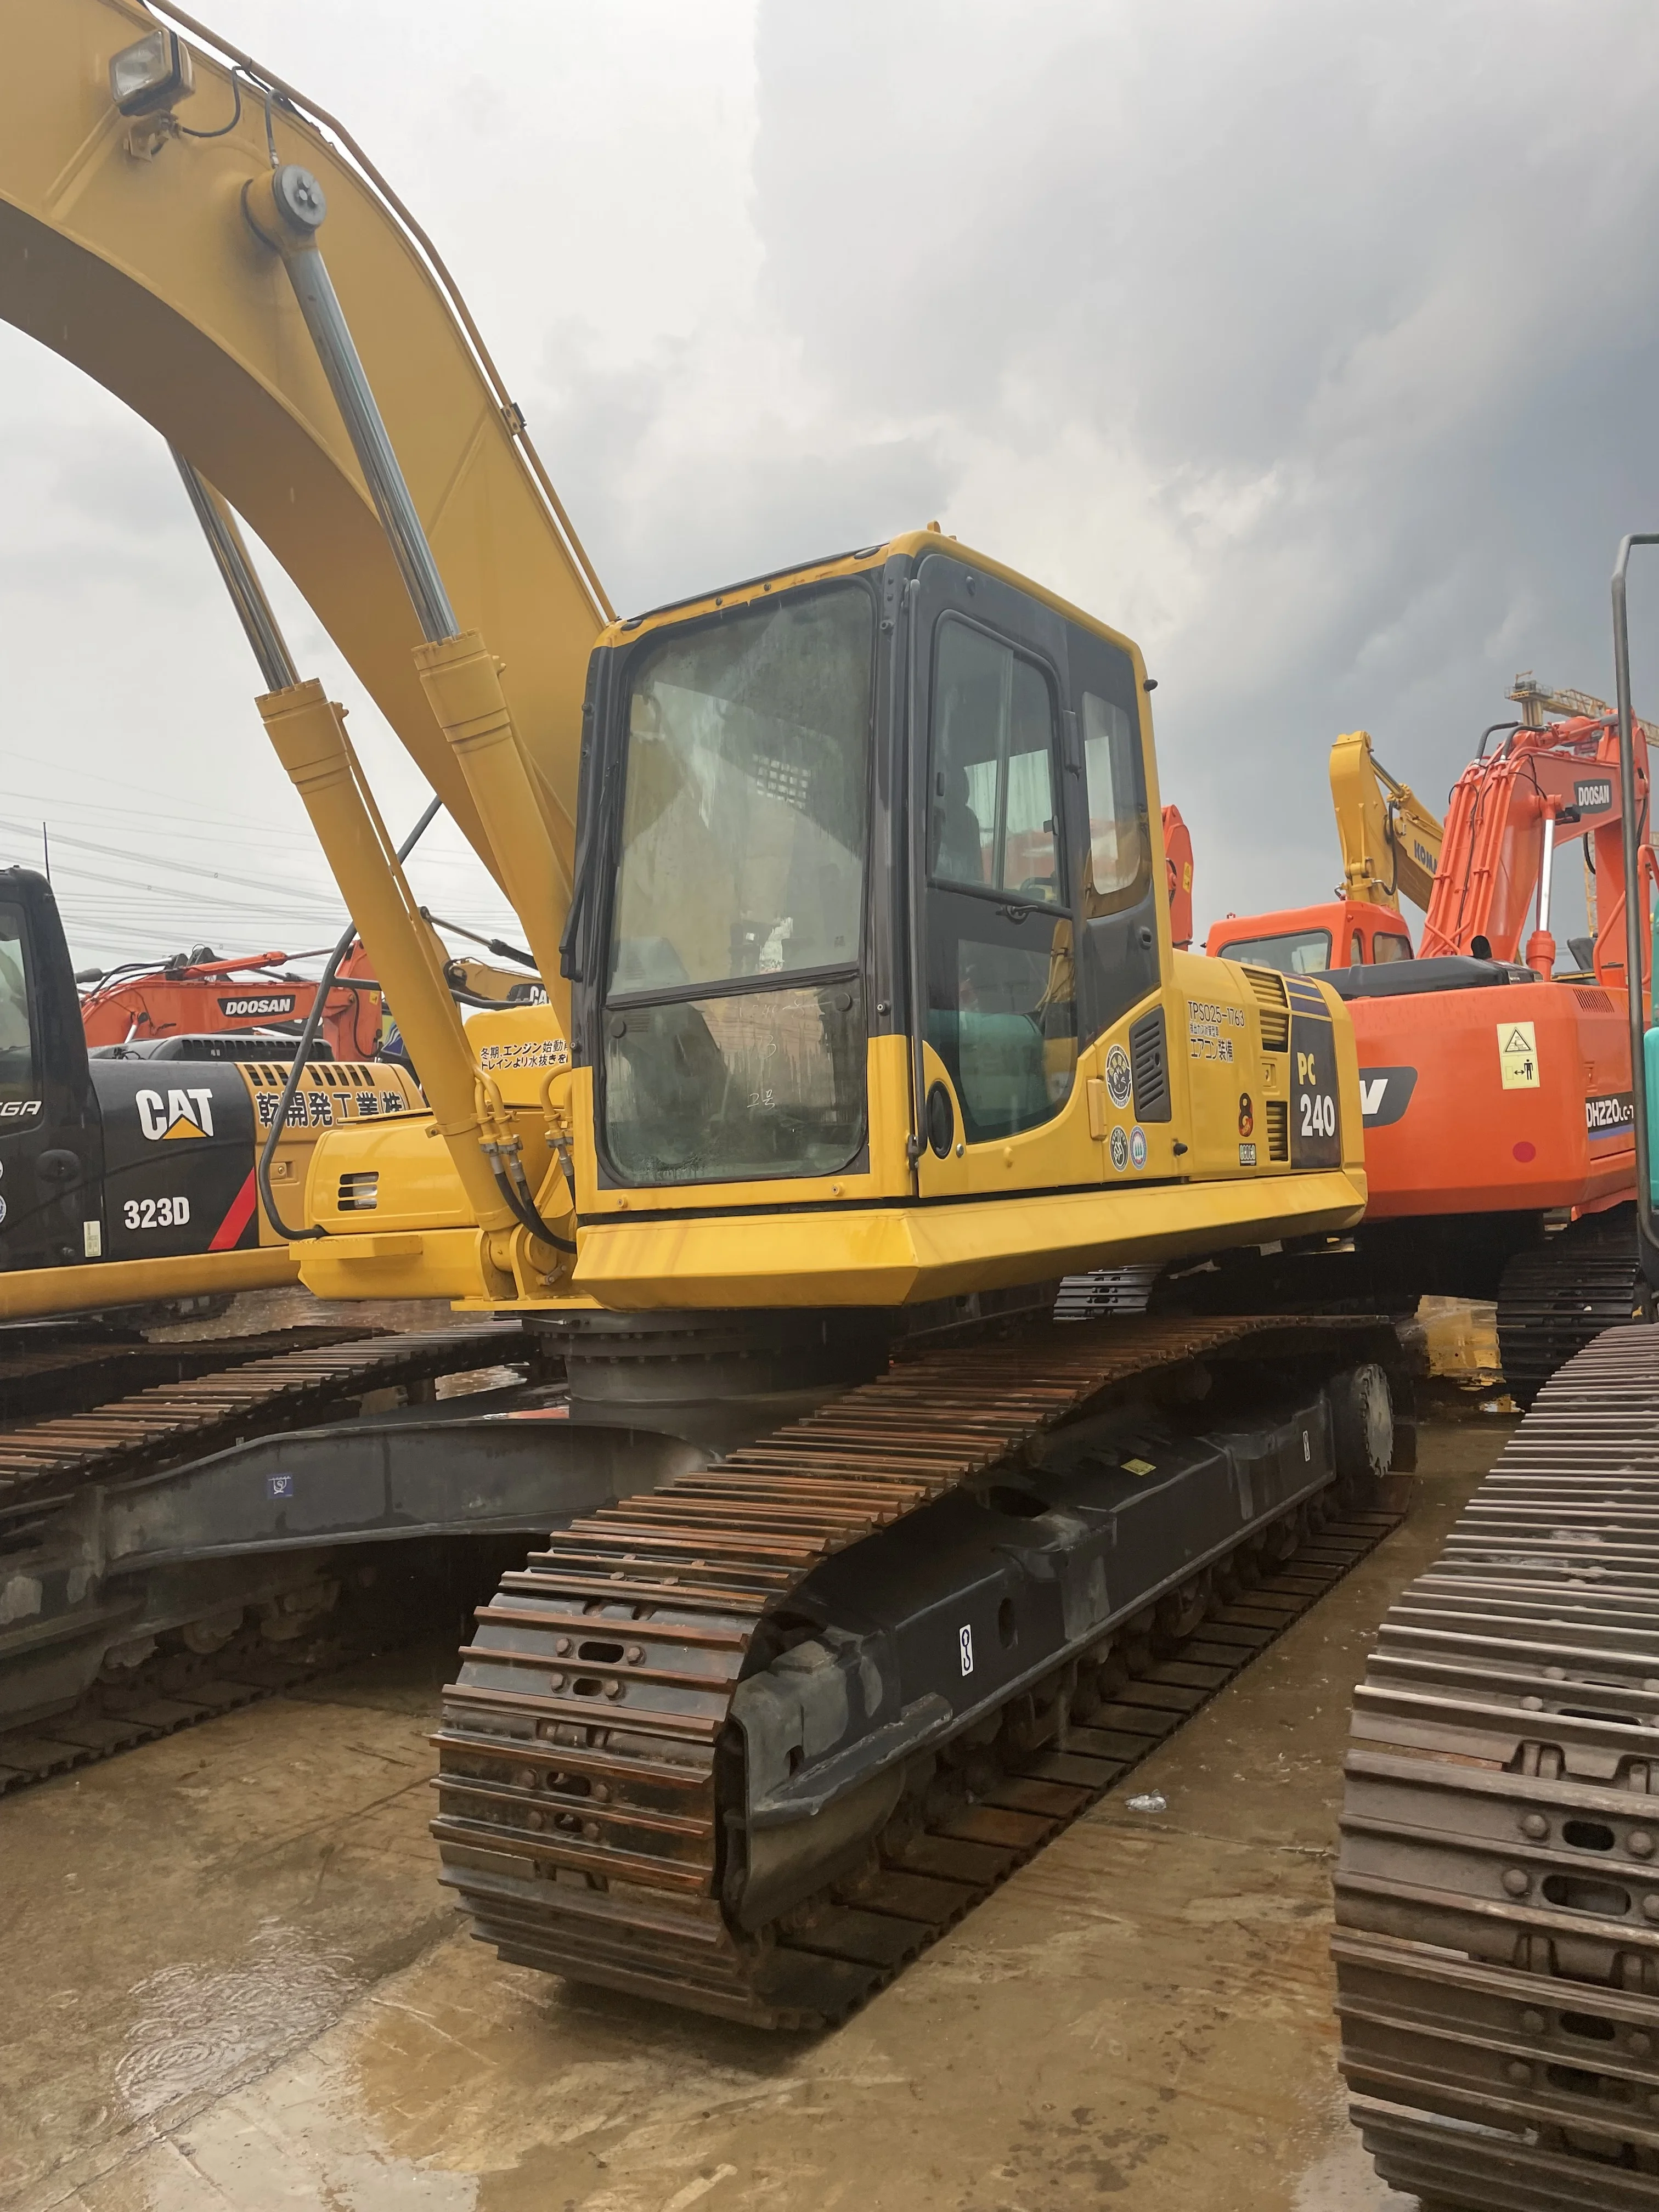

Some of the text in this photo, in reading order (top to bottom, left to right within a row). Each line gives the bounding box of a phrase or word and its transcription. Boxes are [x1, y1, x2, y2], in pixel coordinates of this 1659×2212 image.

[1578, 785, 1610, 806] DOOSAN
[225, 998, 291, 1016] DOOSAN
[1187, 1000, 1245, 1027] TPS025-1763
[1296, 1052, 1316, 1086] PC
[0, 1101, 42, 1116] GA
[136, 1088, 215, 1141] CAT
[1300, 1093, 1335, 1137] 240
[123, 1196, 191, 1230] 323D
